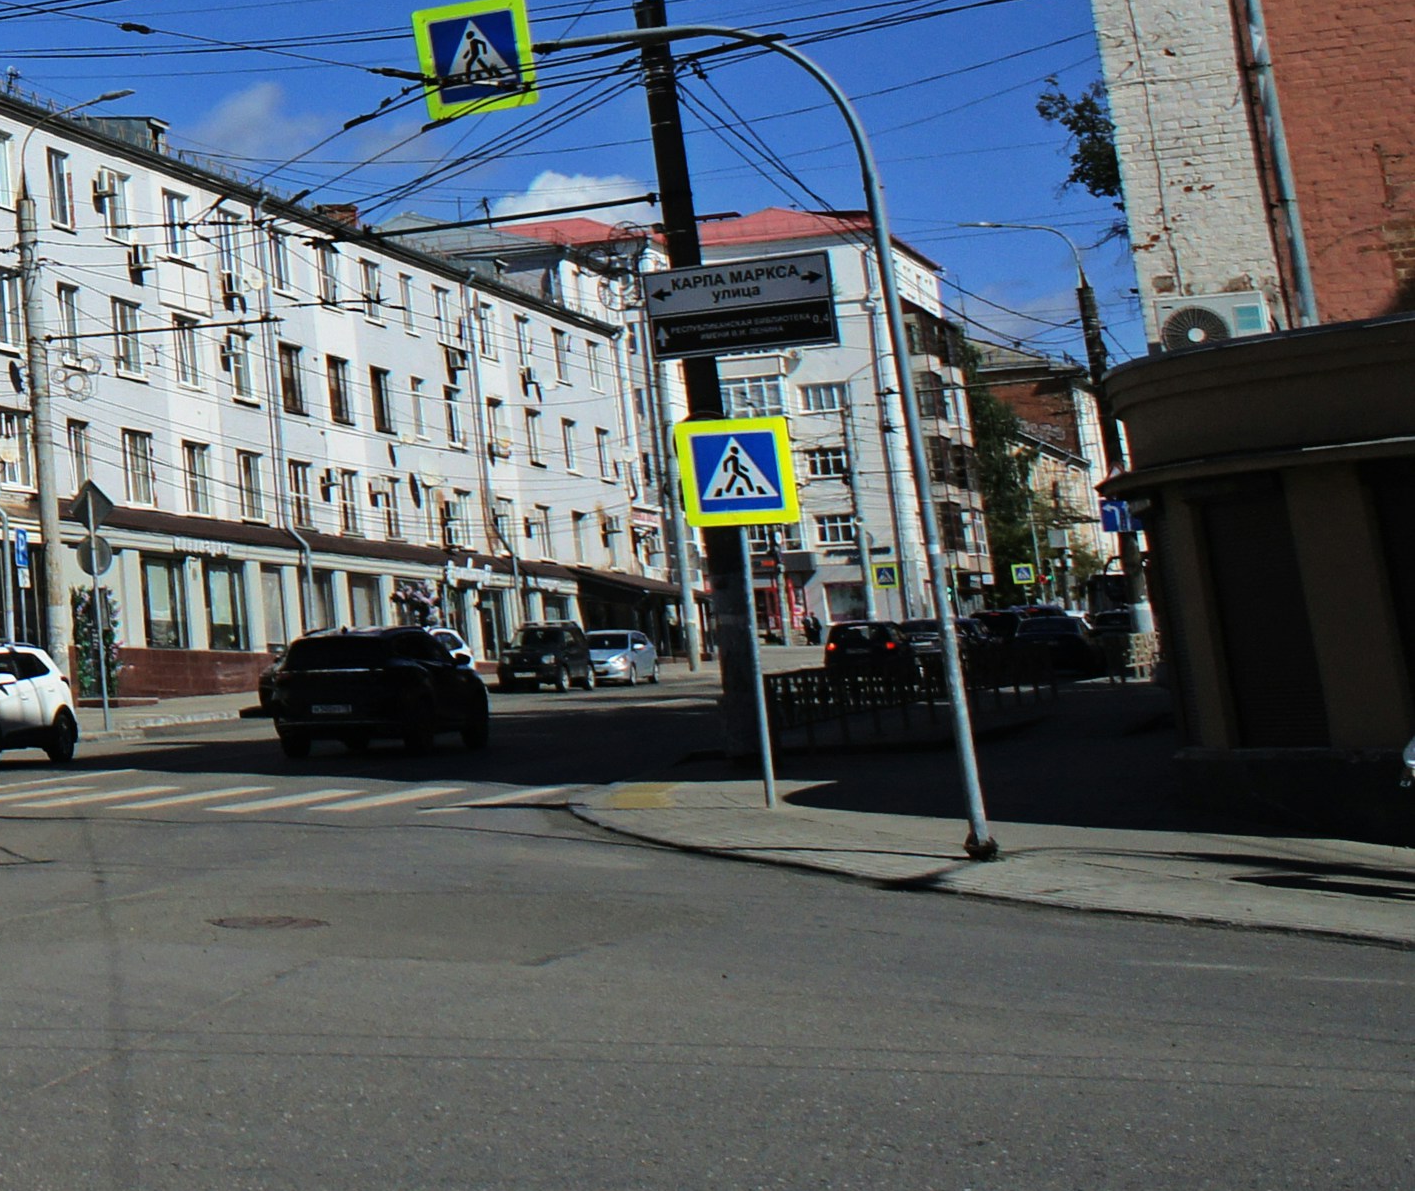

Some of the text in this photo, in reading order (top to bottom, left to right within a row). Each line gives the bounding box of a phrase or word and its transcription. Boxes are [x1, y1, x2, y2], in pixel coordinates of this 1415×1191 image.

[671, 264, 800, 291] КАРЛА МАРКСА
[712, 285, 761, 303] улица
[671, 318, 753, 334] РЕСПУБЛИКАНСКАЯ
[754, 313, 811, 326] БИБЛИОТЕКА
